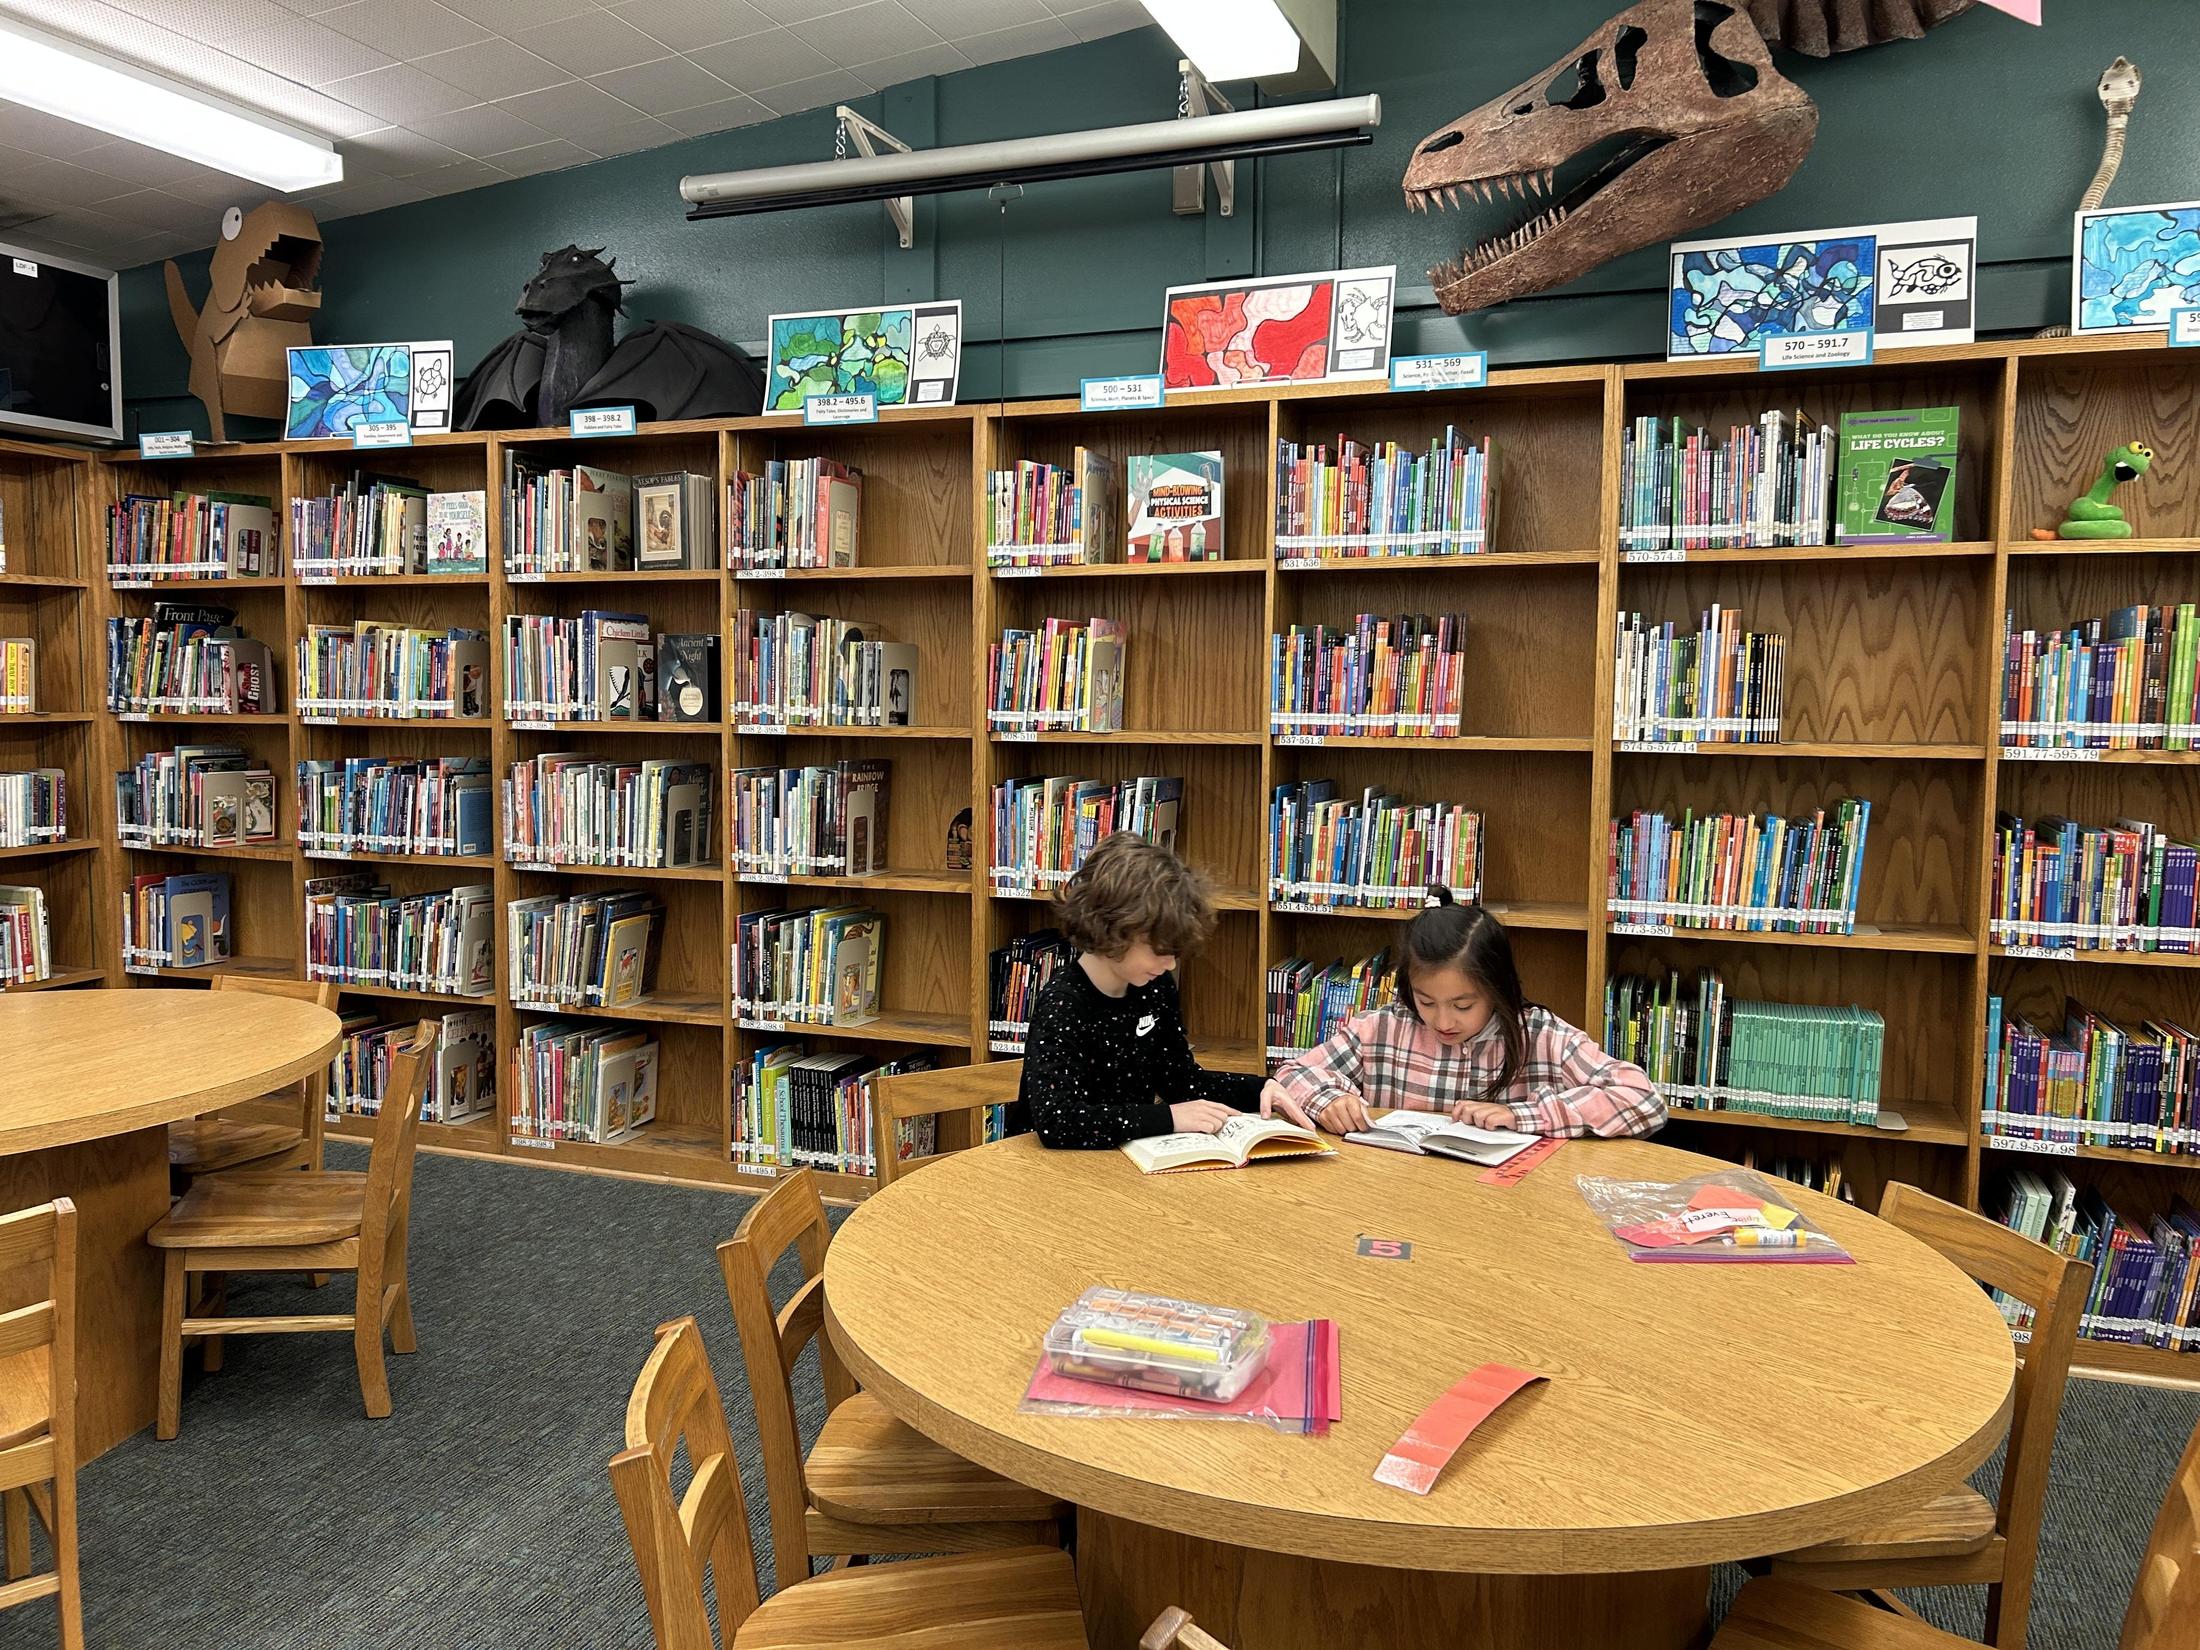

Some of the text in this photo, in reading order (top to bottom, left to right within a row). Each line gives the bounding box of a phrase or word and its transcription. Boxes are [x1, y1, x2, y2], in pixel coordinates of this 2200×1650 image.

[1784, 341, 1805, 351] 570
[1817, 337, 1849, 349] 591.7
[1415, 360, 1433, 369] 531
[1444, 358, 1461, 367] 569
[1103, 385, 1118, 394] 500
[1127, 384, 1142, 393] 531
[817, 398, 838, 407] 398.2
[845, 397, 866, 405] 495.6
[584, 415, 596, 423] 398
[602, 414, 622, 422] 398.2
[368, 424, 380, 432] 305
[1851, 437, 1946, 451] LIFE CYCLES?
[660, 474, 682, 484] FABLES
[1152, 485, 1203, 497] MIND-BLOWING
[1150, 495, 1209, 507] PHYSICAL SCIENCE
[1154, 505, 1204, 519] ACTIVITIES
[1628, 551, 1684, 561] 570-574.5
[1284, 559, 1319, 568] 531-536
[163, 607, 225, 626] Front Page
[606, 625, 646, 638] Chicken Little
[680, 637, 705, 648] Ancient
[681, 650, 702, 663] Night
[247, 662, 261, 701] GHOST
[1001, 732, 1036, 741] 508-510
[1280, 736, 1323, 745] 537-551.3
[1623, 741, 1695, 751] 574.5-577.14
[2005, 749, 2098, 760] 591.77-595.79
[852, 771, 885, 783] RAINBOW
[997, 887, 1030, 897] 511-522
[1277, 901, 1332, 913] 551.4-551.51
[1616, 923, 1671, 936] 577.3-580
[2007, 945, 2072, 959] 597-597.8
[740, 1019, 784, 1031] 398.2-398.9
[993, 1042, 1024, 1053] 523.44-
[778, 1090, 786, 1112] School
[1992, 1138, 2076, 1155] 597.9-597.98
[738, 1165, 776, 1176] 411-495.6
[1369, 1240, 1402, 1257] 5
[2010, 1331, 2030, 1342] 98
